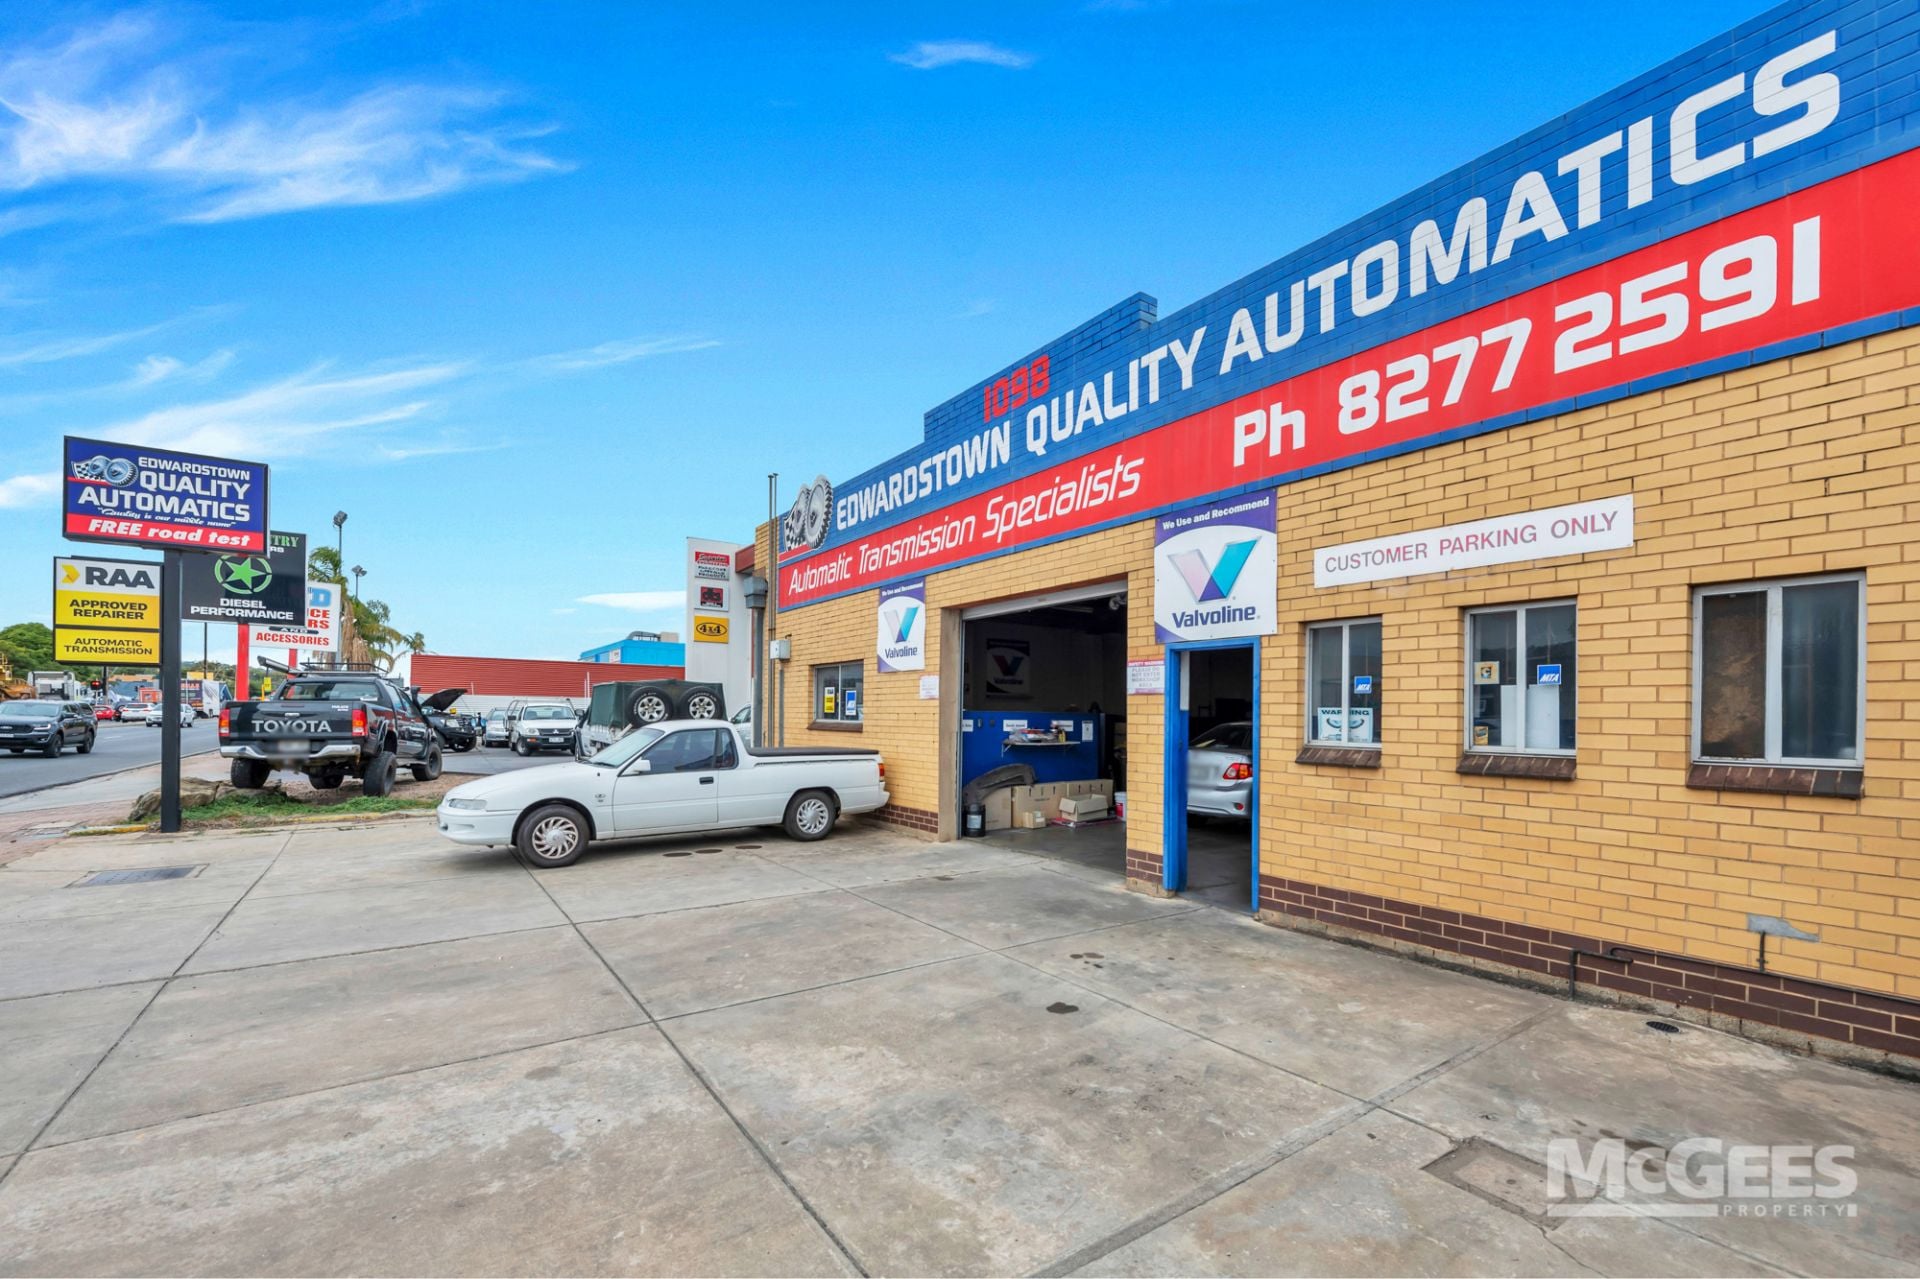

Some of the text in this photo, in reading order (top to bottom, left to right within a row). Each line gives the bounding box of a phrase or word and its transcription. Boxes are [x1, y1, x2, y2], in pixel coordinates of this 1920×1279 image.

[836, 30, 1841, 531] EDWARDSTOWN QUALITY AUTOMATICS
[984, 355, 1050, 423] 1098
[788, 215, 1821, 596] Automatic Transmission Specialists Ph 8277 2591
[138, 456, 251, 481] EDWARDSTOWN
[139, 470, 251, 500] QUALITY
[77, 486, 251, 522] AUTOMATICS
[1162, 496, 1270, 530] We Use and Recommend
[88, 519, 251, 547] FREE road test
[1324, 510, 1620, 574] CUSTOMER PARKING ONLY
[85, 566, 155, 589] RAA
[70, 599, 148, 611] APPROVED
[73, 608, 144, 620] REPAIRER
[190, 605, 294, 621] PERFORMANCE
[220, 598, 267, 609] DIESEL
[1172, 606, 1257, 629] Valvoline
[64, 645, 152, 655] TRANSMISSION
[74, 638, 142, 648] AUTOMATIC
[256, 632, 330, 646] ACCESSORIES
[884, 645, 918, 659] Valvoline
[251, 720, 332, 733] TOYOTA
